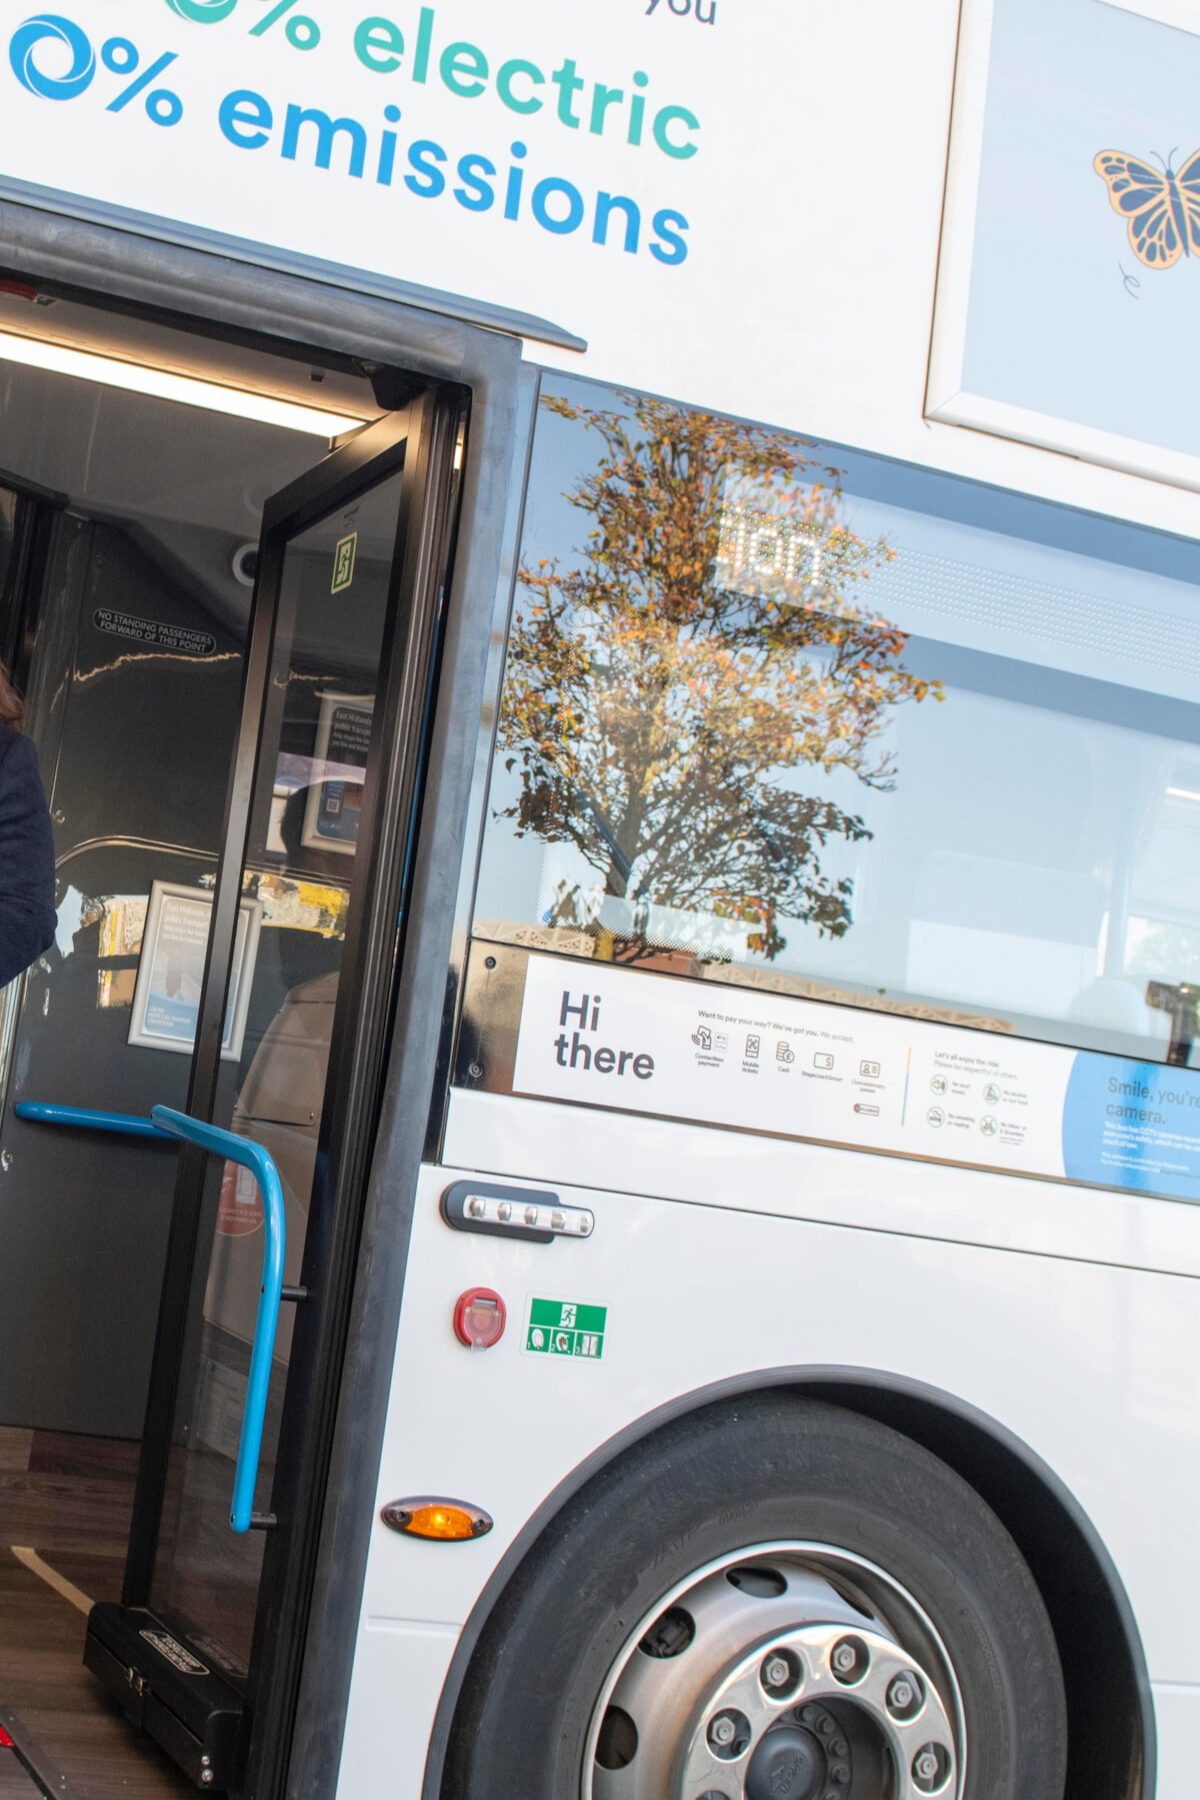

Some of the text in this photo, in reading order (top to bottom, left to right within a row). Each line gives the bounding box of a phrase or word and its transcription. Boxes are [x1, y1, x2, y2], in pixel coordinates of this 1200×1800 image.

[354, 6, 701, 160] electric
[8, 14, 690, 266] 0% emissions
[98, 610, 212, 645] NO STANDING PASSENGERS
[100, 620, 207, 652] FORWARD OF THIS POINT
[560, 990, 602, 1032] Hi
[698, 1010, 716, 1020] Want
[725, 1016, 737, 1025] pay
[738, 1018, 752, 1027] your
[554, 1031, 655, 1080] there
[1108, 1077, 1154, 1103] Smile,
[1106, 1103, 1166, 1124] camera.
